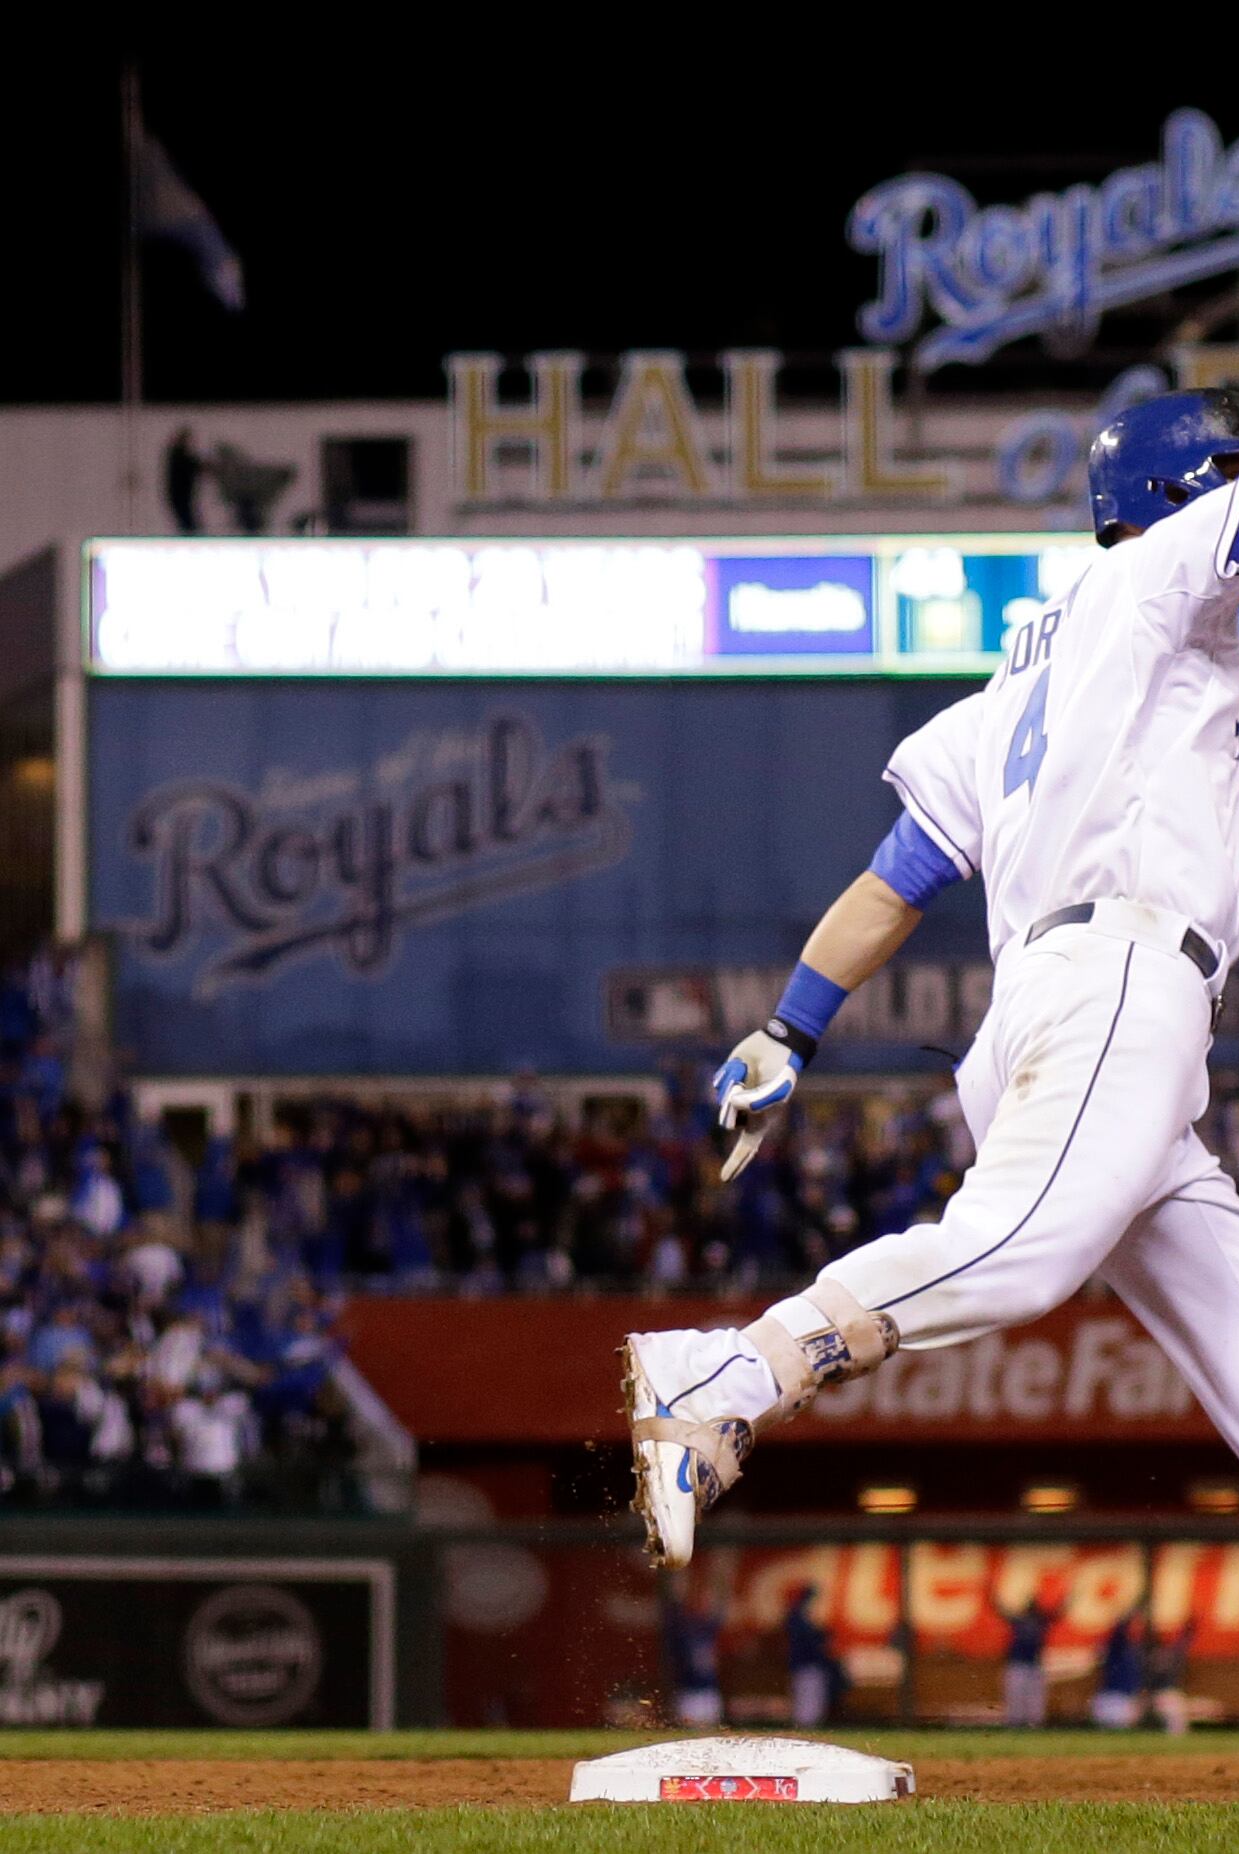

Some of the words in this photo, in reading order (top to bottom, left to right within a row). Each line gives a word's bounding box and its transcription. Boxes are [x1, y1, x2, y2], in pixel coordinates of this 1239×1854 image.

[443, 349, 962, 500] HALL
[1003, 663, 1049, 803] 4
[106, 705, 636, 995] Royals
